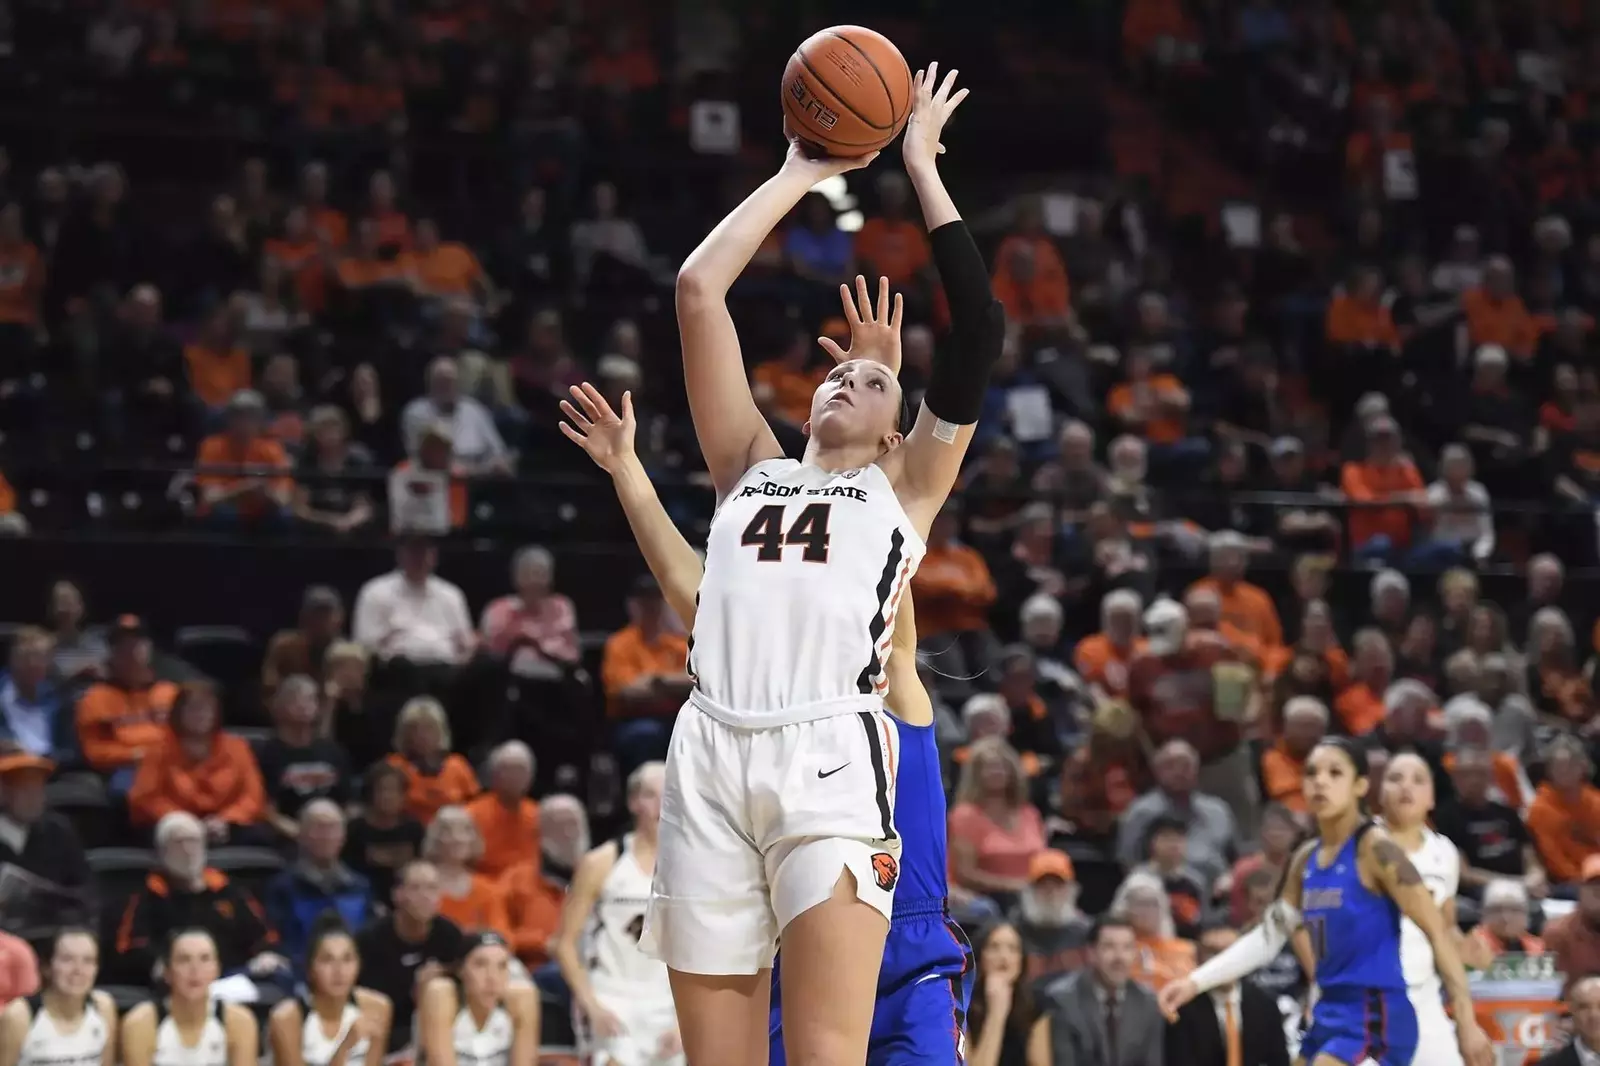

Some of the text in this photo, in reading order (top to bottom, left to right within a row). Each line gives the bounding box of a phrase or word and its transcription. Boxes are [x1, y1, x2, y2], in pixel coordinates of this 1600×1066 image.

[790, 77, 838, 131] ELITE
[732, 481, 869, 503] RGON STATE
[740, 502, 832, 564] 44
